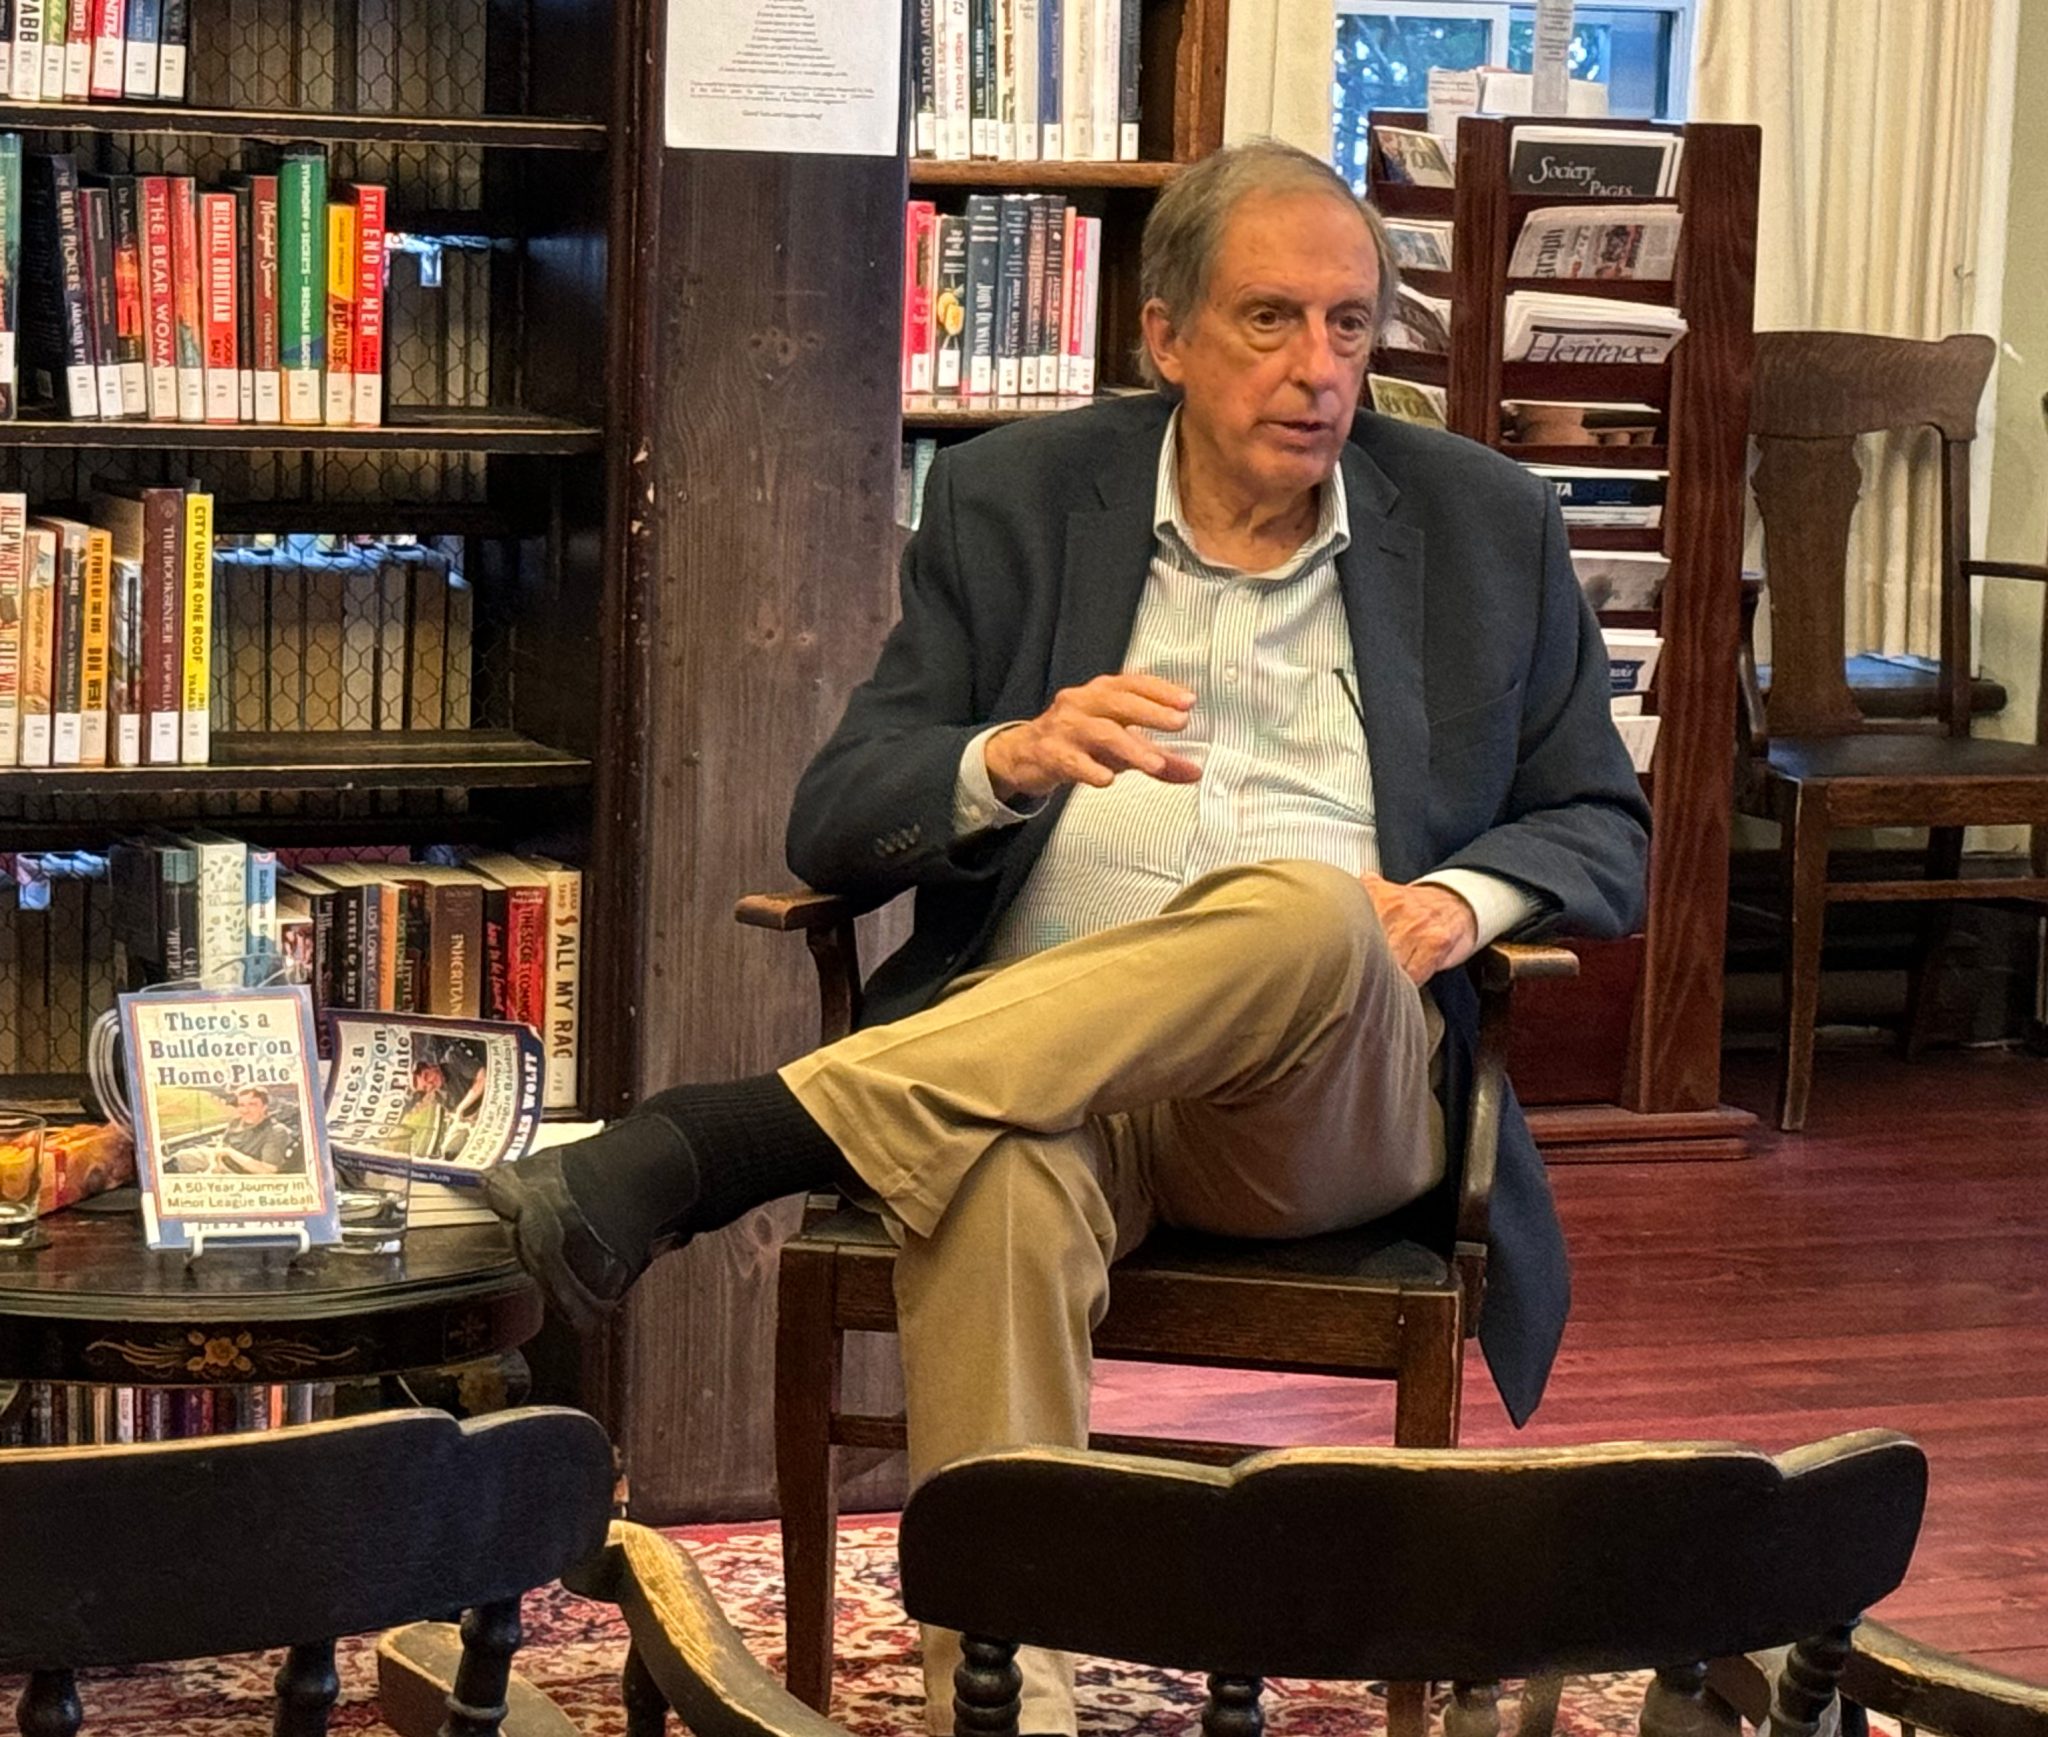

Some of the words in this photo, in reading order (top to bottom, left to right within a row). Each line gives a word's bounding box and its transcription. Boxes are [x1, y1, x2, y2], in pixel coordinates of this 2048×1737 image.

[21, 0, 40, 43] ABB
[921, 46, 932, 93] DOYLE
[1528, 156, 1597, 185] Society
[1590, 181, 1633, 196] PAGES
[59, 190, 75, 231] BERRY
[149, 193, 166, 235] THE
[363, 193, 378, 221] THE
[212, 200, 231, 254] MICHAEL
[362, 227, 381, 265] END
[152, 244, 169, 294] BEAR
[362, 272, 376, 291] OF
[212, 257, 232, 323] ROBOTHAM
[332, 303, 348, 364] BECAUSE
[361, 296, 379, 337] MEN
[163, 524, 176, 553] THE
[194, 505, 207, 538] CITY
[92, 537, 104, 554] THE
[193, 540, 206, 589] UNDER
[91, 555, 104, 586] POWER
[162, 555, 176, 644] BOOKBINDER
[192, 593, 205, 622] ONE
[87, 647, 102, 671] DON
[191, 625, 204, 664] ROOF
[187, 673, 198, 711] YAMAS
[367, 905, 378, 930] LOIS
[367, 933, 378, 972] LOWRY
[556, 933, 575, 972] ALL
[449, 933, 464, 1017] INHERITAN
[556, 981, 574, 1012] MY
[164, 1009, 250, 1031] There's
[257, 1013, 270, 1028] a
[149, 1039, 259, 1059] Bulldozer
[266, 1040, 293, 1055] on
[352, 1046, 365, 1058] a
[373, 1029, 388, 1056] on
[157, 1066, 225, 1085] Home
[230, 1063, 290, 1084] Plate
[391, 1035, 410, 1092] Plate
[489, 1059, 502, 1106] Journey
[501, 1038, 513, 1092] Baseball
[522, 1052, 538, 1110] WOLFF
[168, 1197, 204, 1208] Minor
[208, 1195, 255, 1209] League
[259, 1194, 314, 1207] Baseball
[173, 1182, 182, 1194] A
[239, 1180, 288, 1195] Journey
[292, 1180, 305, 1191] in
